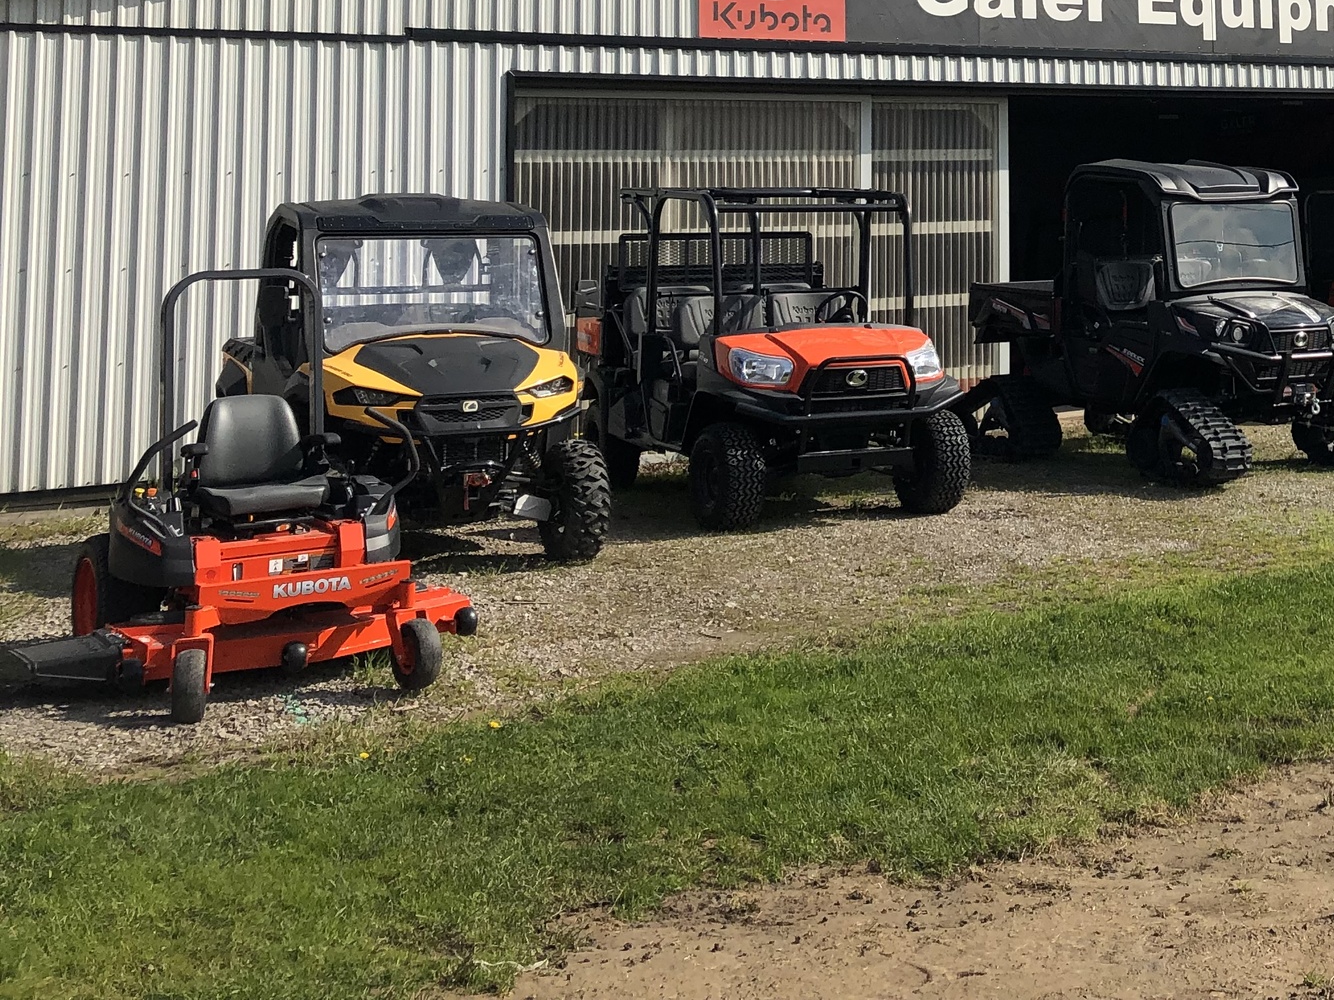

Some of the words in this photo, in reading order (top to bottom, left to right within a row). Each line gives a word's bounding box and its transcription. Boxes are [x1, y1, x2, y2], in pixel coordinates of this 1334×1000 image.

[713, 1, 832, 33] Kubota
[128, 528, 153, 547] KUBOTA
[272, 576, 352, 599] KUBOTA
